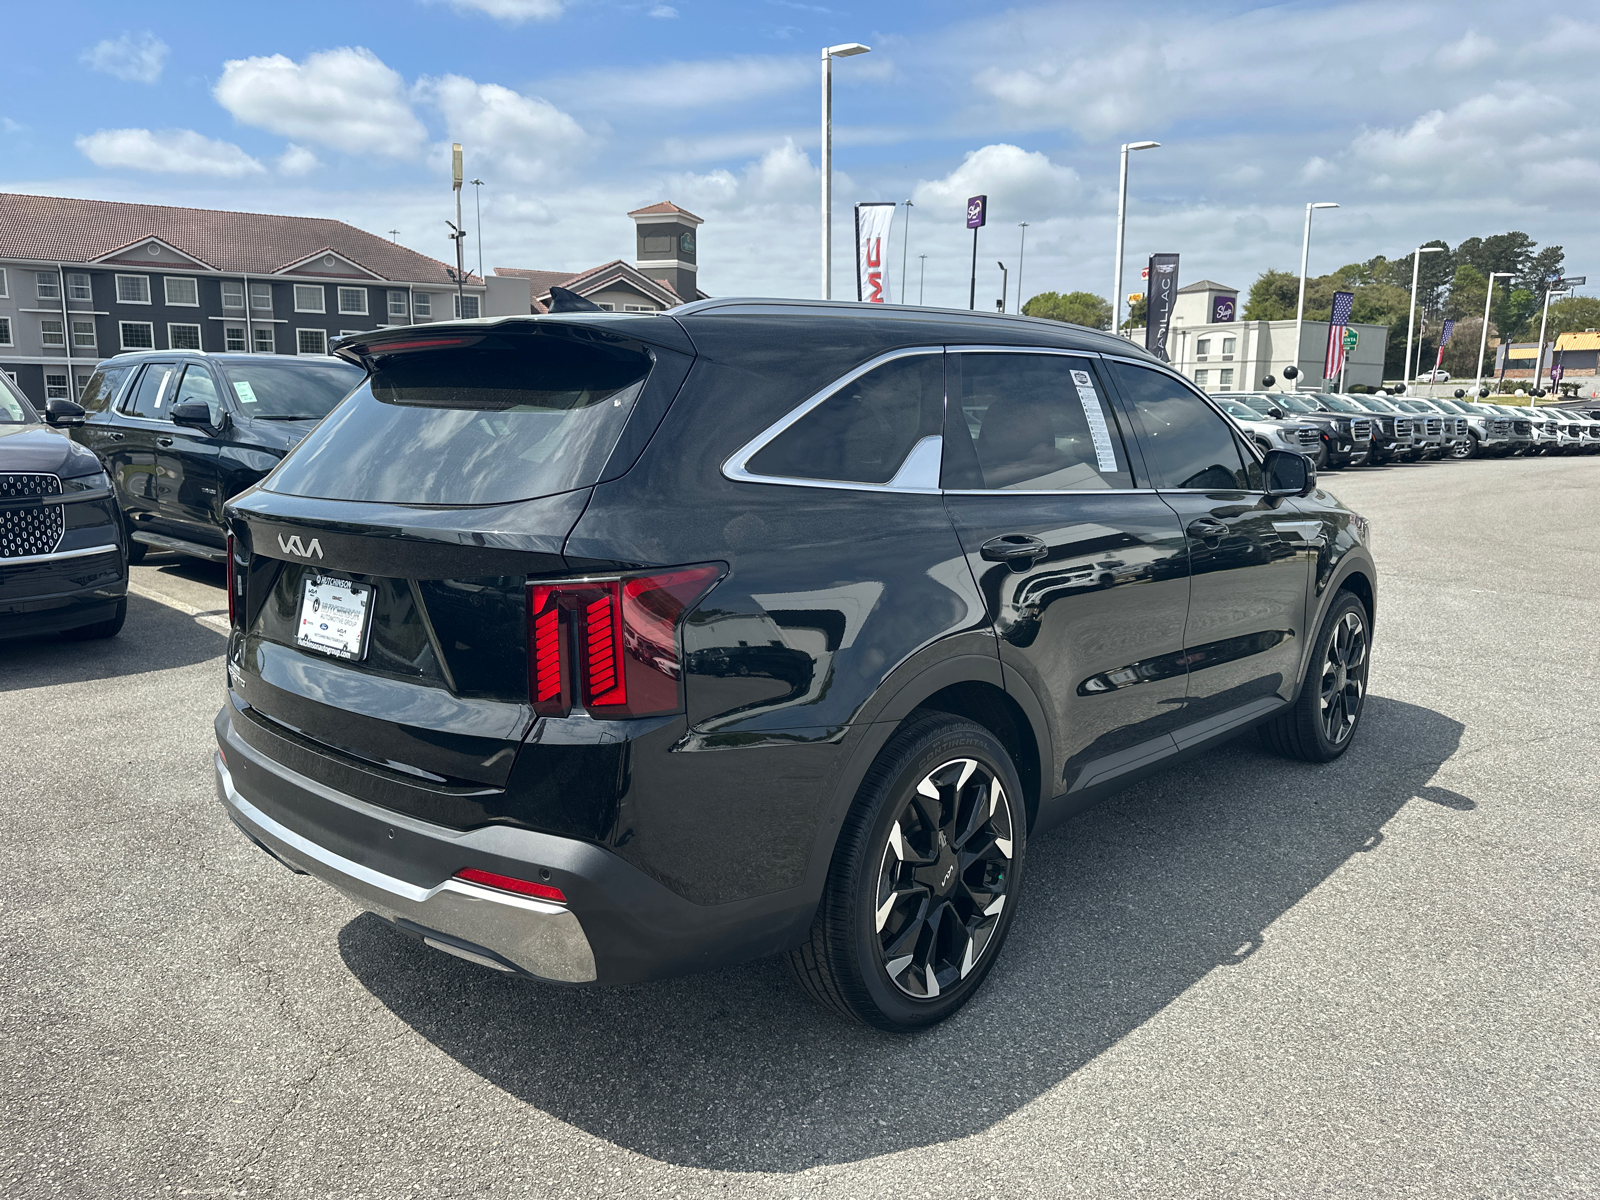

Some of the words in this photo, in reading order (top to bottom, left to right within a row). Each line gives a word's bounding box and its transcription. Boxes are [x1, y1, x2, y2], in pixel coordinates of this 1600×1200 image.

[866, 237, 884, 303] MC
[1158, 279, 1170, 360] CADILLAC
[320, 576, 352, 589] HUTCHINSON
